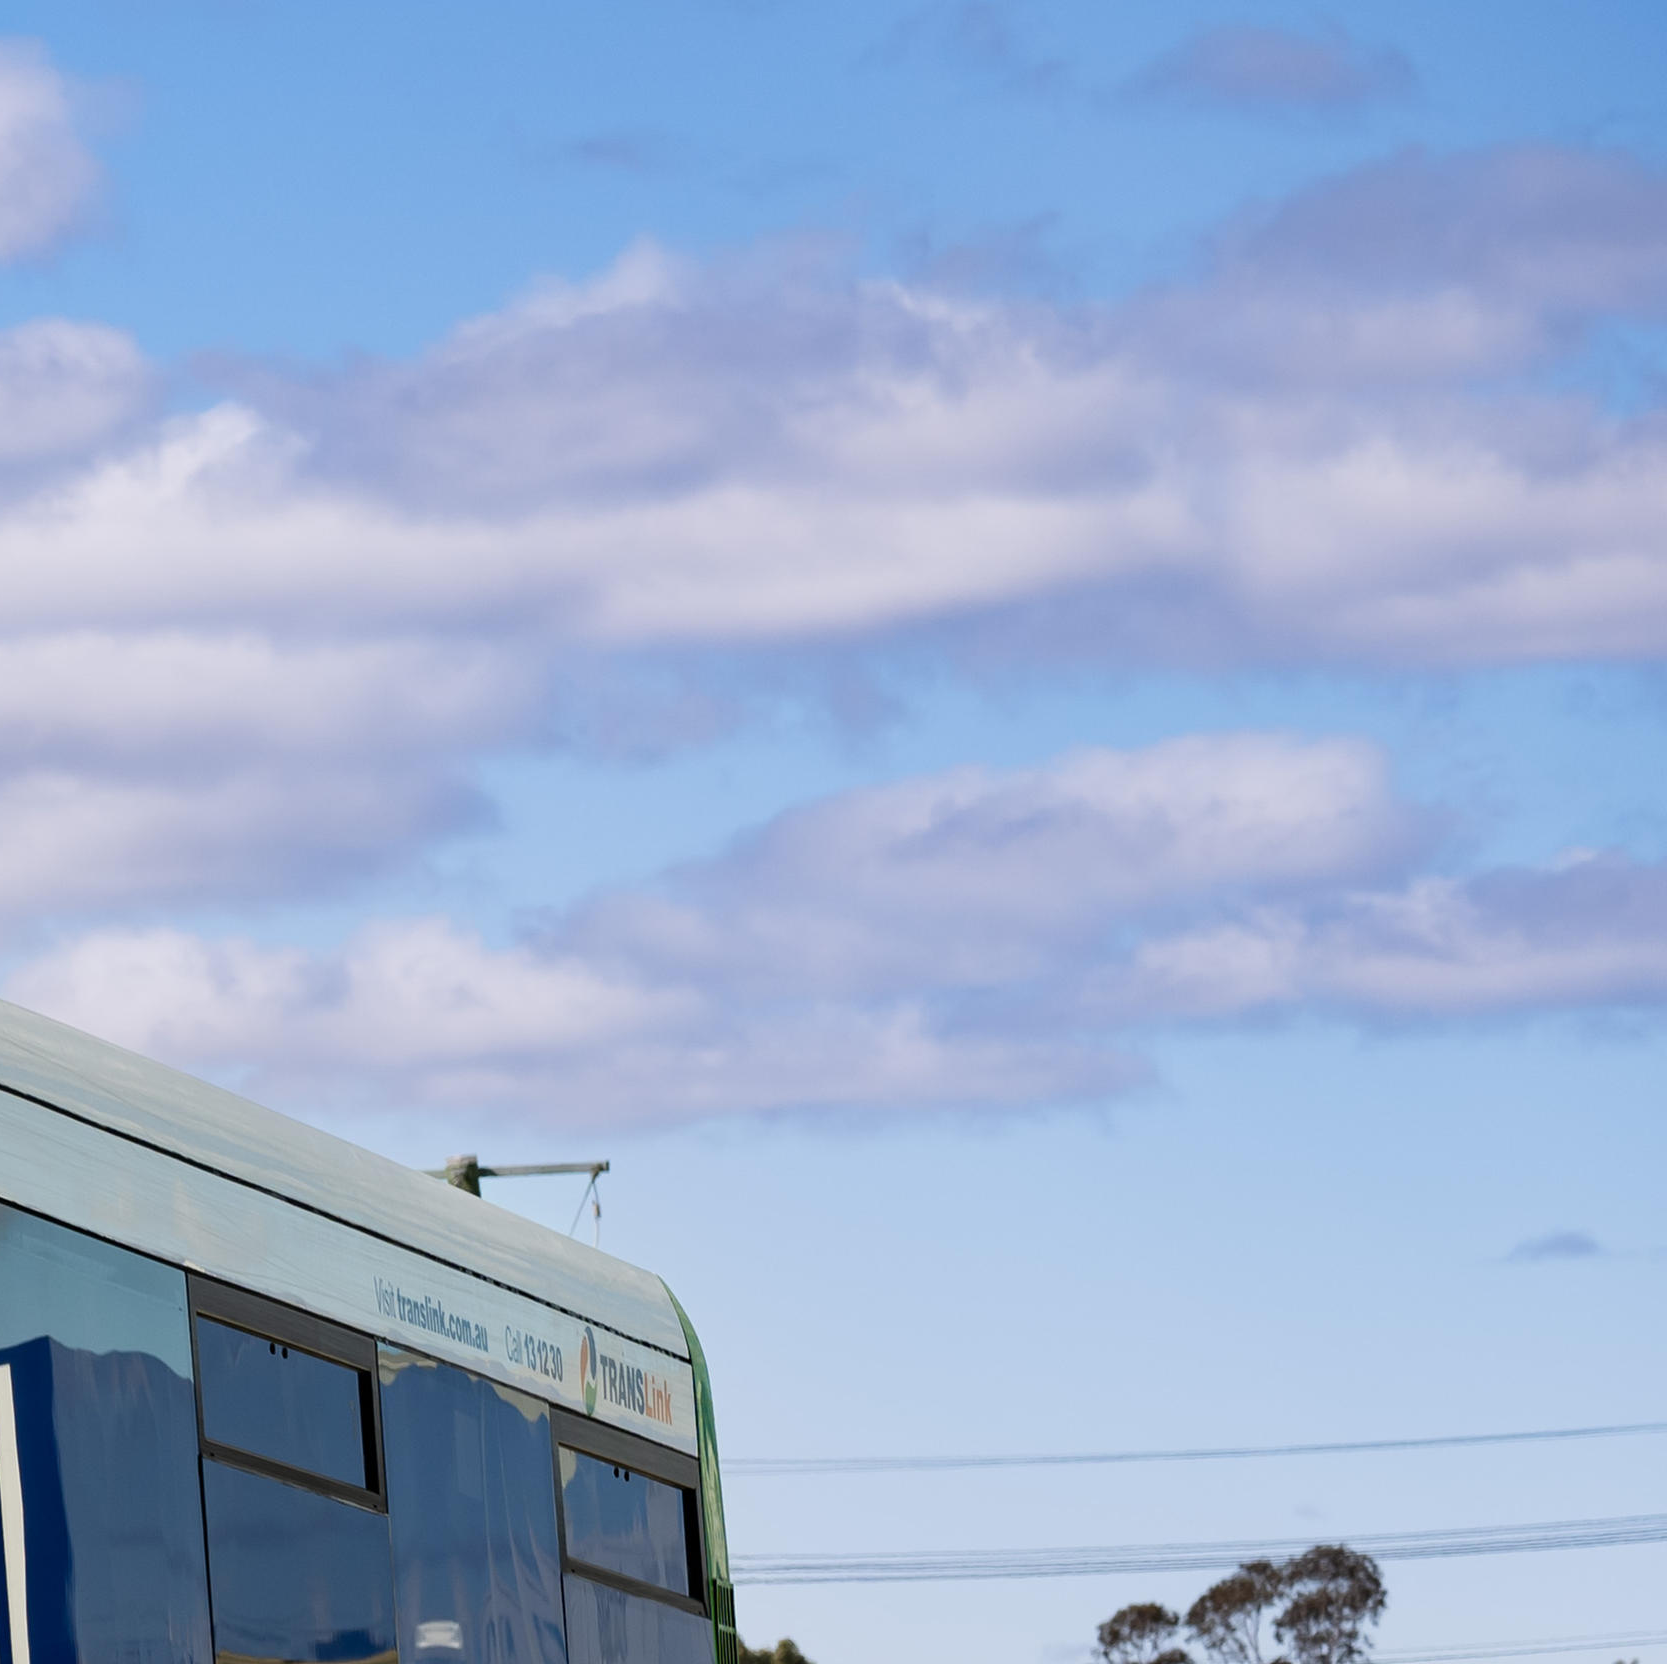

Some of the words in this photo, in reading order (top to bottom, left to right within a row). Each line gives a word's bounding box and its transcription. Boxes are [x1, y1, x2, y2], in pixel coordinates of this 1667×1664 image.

[373, 1275, 397, 1320] Visit
[397, 1287, 489, 1353] translink.com.au
[505, 1325, 524, 1365] Call
[599, 1354, 673, 1426] TRANSLink
